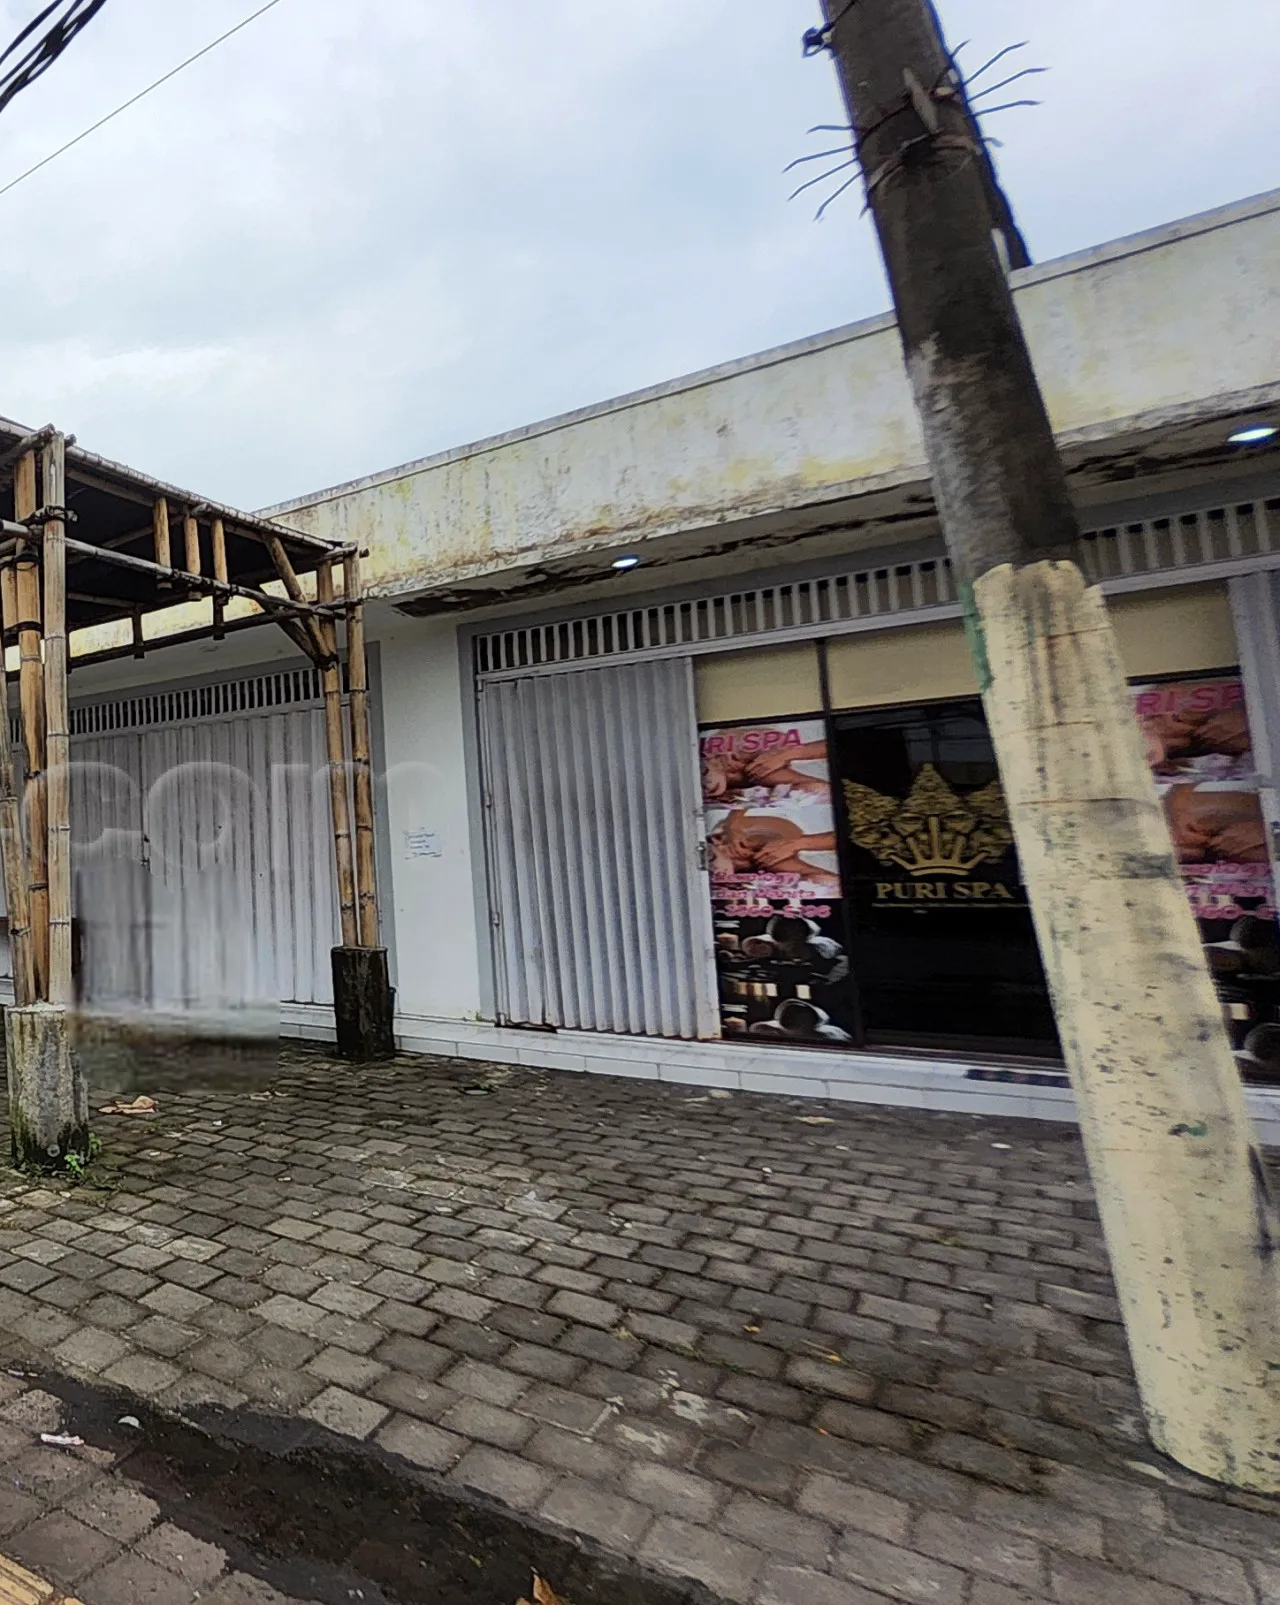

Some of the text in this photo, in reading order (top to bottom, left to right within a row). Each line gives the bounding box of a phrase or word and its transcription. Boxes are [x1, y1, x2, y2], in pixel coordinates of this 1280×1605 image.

[743, 729, 803, 753] SPA
[875, 881, 1015, 899] PURI SPA
